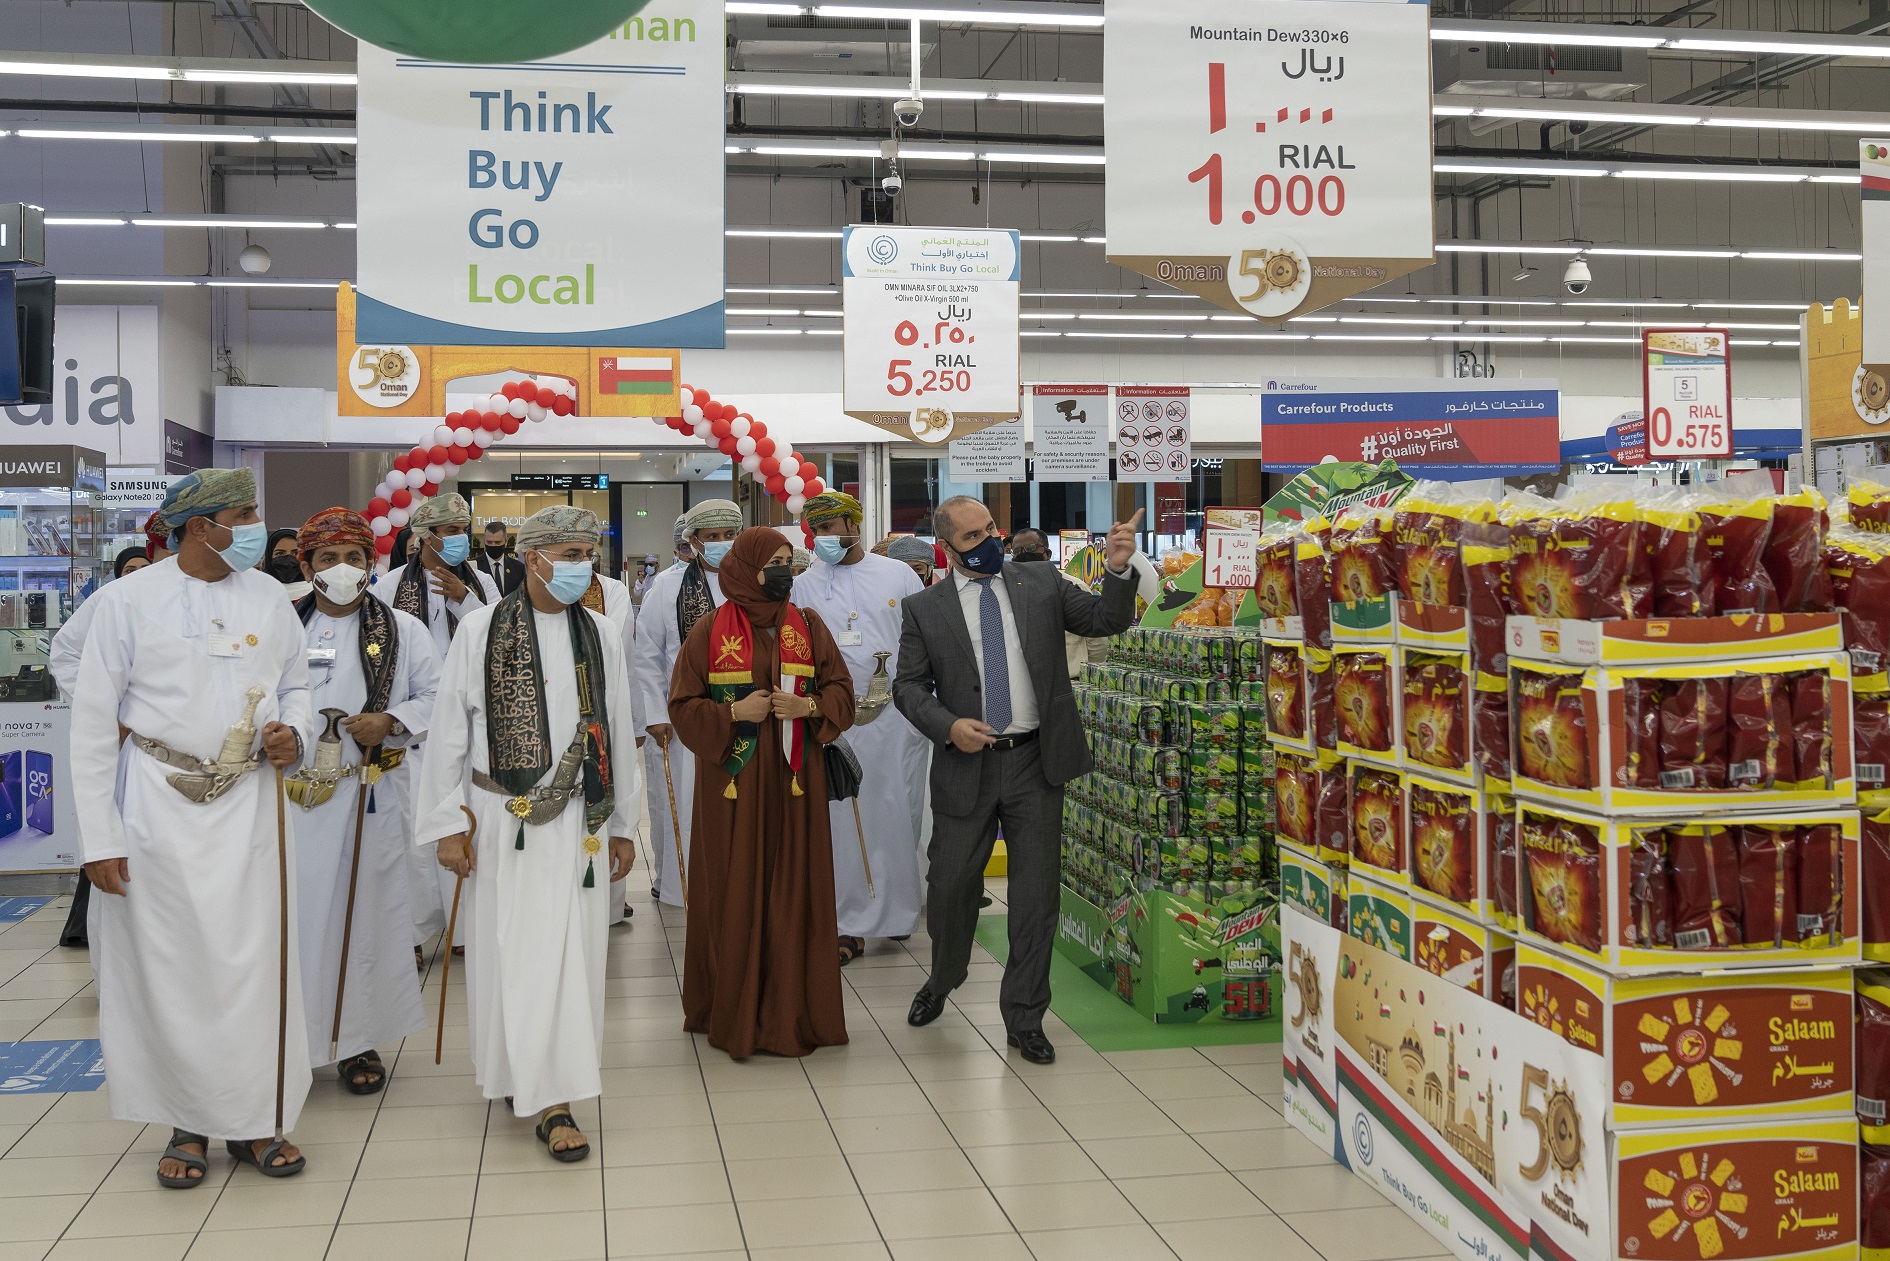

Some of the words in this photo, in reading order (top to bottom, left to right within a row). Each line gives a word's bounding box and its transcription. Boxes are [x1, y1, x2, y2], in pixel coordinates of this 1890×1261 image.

[1190, 26, 1262, 42] Mountain
[1281, 48, 1344, 82] ريال
[470, 89, 614, 134] Think
[1279, 144, 1356, 169] RIAL
[469, 150, 563, 201] Buy
[1188, 153, 1345, 225] 1.000
[469, 208, 539, 249] Go
[910, 263, 937, 272] Think
[939, 263, 957, 275] Buy
[960, 264, 973, 273] Go
[976, 264, 1000, 274] Local
[1156, 260, 1223, 281] Oman
[1313, 265, 1362, 279] National
[1363, 266, 1387, 281] Day
[469, 264, 595, 305] Local
[938, 284, 948, 292] OIL
[924, 295, 948, 304] X-Virgin
[961, 295, 969, 303] ml
[937, 304, 972, 322] ريال
[935, 354, 977, 368] RIAL
[380, 383, 408, 392] Oman
[886, 359, 971, 397] 5.250
[1280, 383, 1318, 391] Carrefour
[1681, 379, 1689, 390] 5
[1277, 403, 1337, 415] Carrefour
[1340, 401, 1394, 413] Products
[1445, 399, 1489, 414] كارفور
[1491, 399, 1545, 411] منتجات
[1689, 405, 1723, 418] RIAL
[872, 413, 908, 425] Oman
[1617, 424, 1631, 433] SAVE
[1652, 407, 1723, 448] 0.575
[1404, 423, 1453, 440] الجودة
[1381, 445, 1427, 459] Quality
[1429, 437, 1459, 453] First
[110, 481, 167, 490] SAMSUNG
[95, 494, 122, 502] Galaxy
[1322, 484, 1385, 515] Mountain
[476, 516, 498, 526] THE
[1212, 565, 1251, 586] 1.000
[35, 722, 40, 730] 7
[1219, 906, 1261, 931] Mountain
[1225, 906, 1271, 942] DEW
[1235, 938, 1261, 956] العيد
[1227, 955, 1268, 973] الوطني
[1225, 982, 1268, 1012] 50
[1768, 1016, 1835, 1046] Salaam
[1772, 1054, 1834, 1087] سلام
[1774, 1168, 1840, 1198] Salaam
[1382, 1167, 1402, 1194] Think
[1402, 1183, 1416, 1208] Buy
[1417, 1195, 1428, 1214] Go
[1429, 1204, 1449, 1231] Local
[1553, 1182, 1575, 1209] Oman
[1541, 1191, 1571, 1223] National
[1571, 1210, 1590, 1238] Day
[1777, 1206, 1839, 1240] سلام
